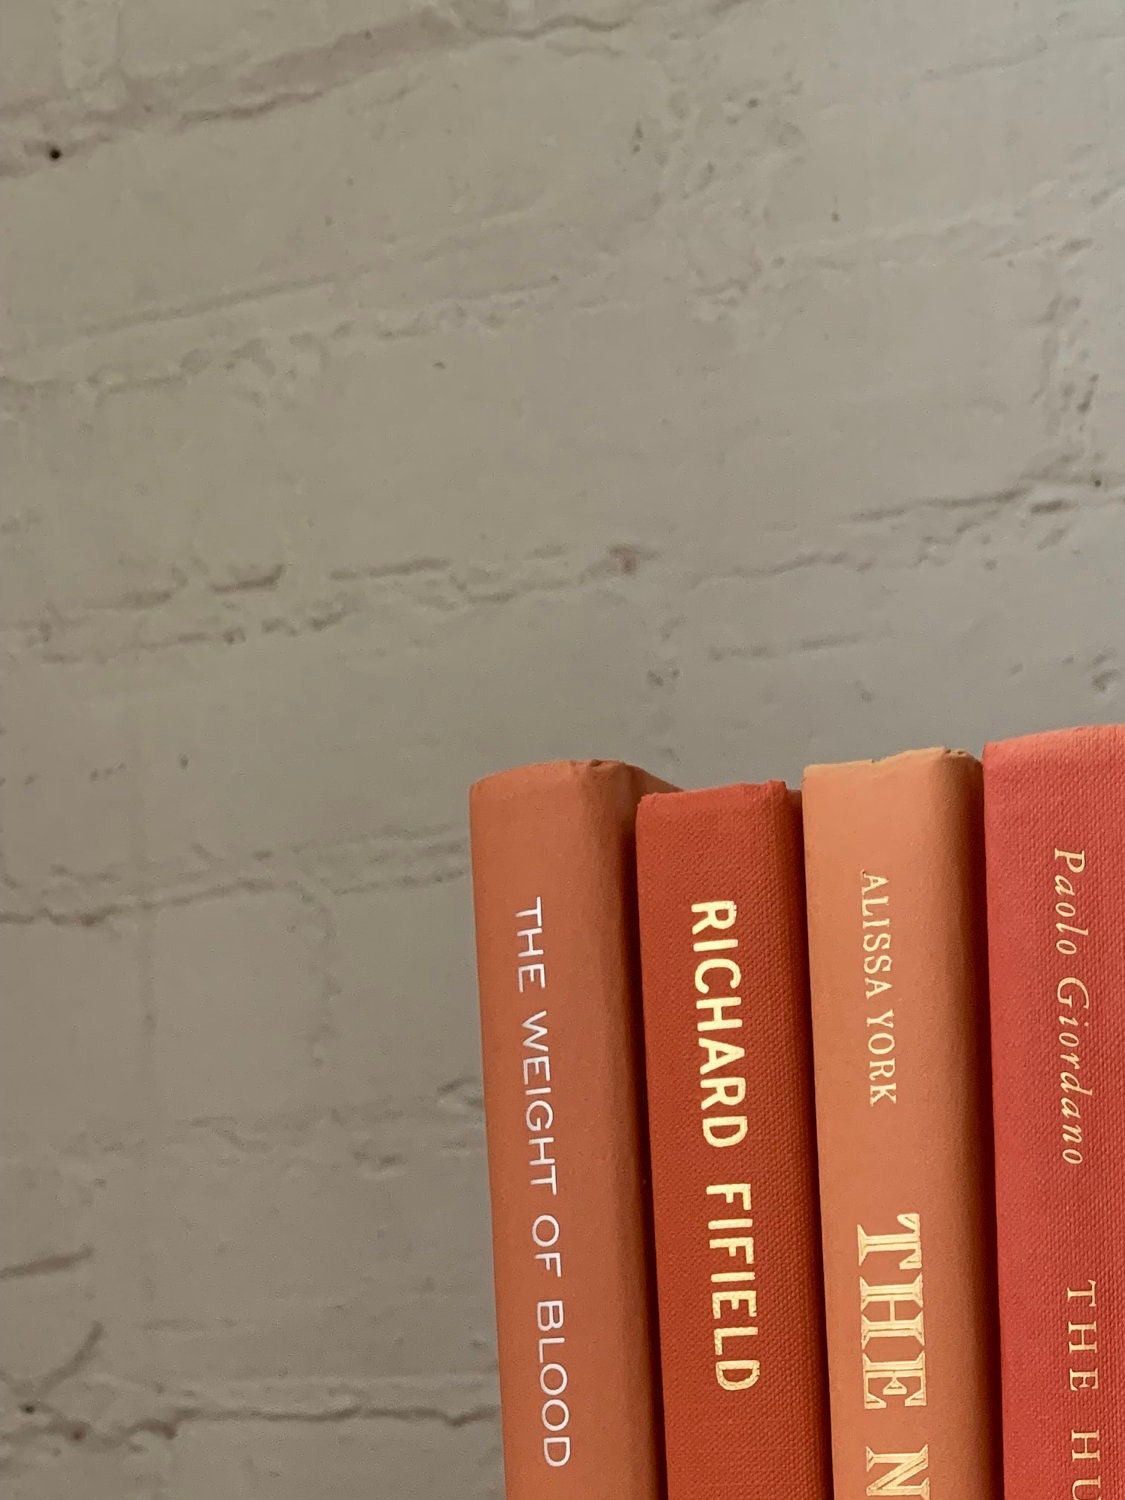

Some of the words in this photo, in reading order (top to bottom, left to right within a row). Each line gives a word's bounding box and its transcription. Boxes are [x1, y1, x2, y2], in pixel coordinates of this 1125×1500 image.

[514, 896, 545, 993] THE
[861, 870, 890, 997] ALISSA
[1052, 846, 1089, 957] Paolo
[690, 899, 748, 1148] RICHARD
[865, 1009, 897, 1107] YORK
[1055, 976, 1096, 1166] Giordano
[521, 1010, 557, 1195] WEIGHT
[531, 1214, 562, 1278] OF
[705, 1181, 761, 1392] FIFIELD
[856, 1213, 928, 1410] THE
[537, 1299, 570, 1467] BLOOD
[1066, 1279, 1098, 1393] THE
